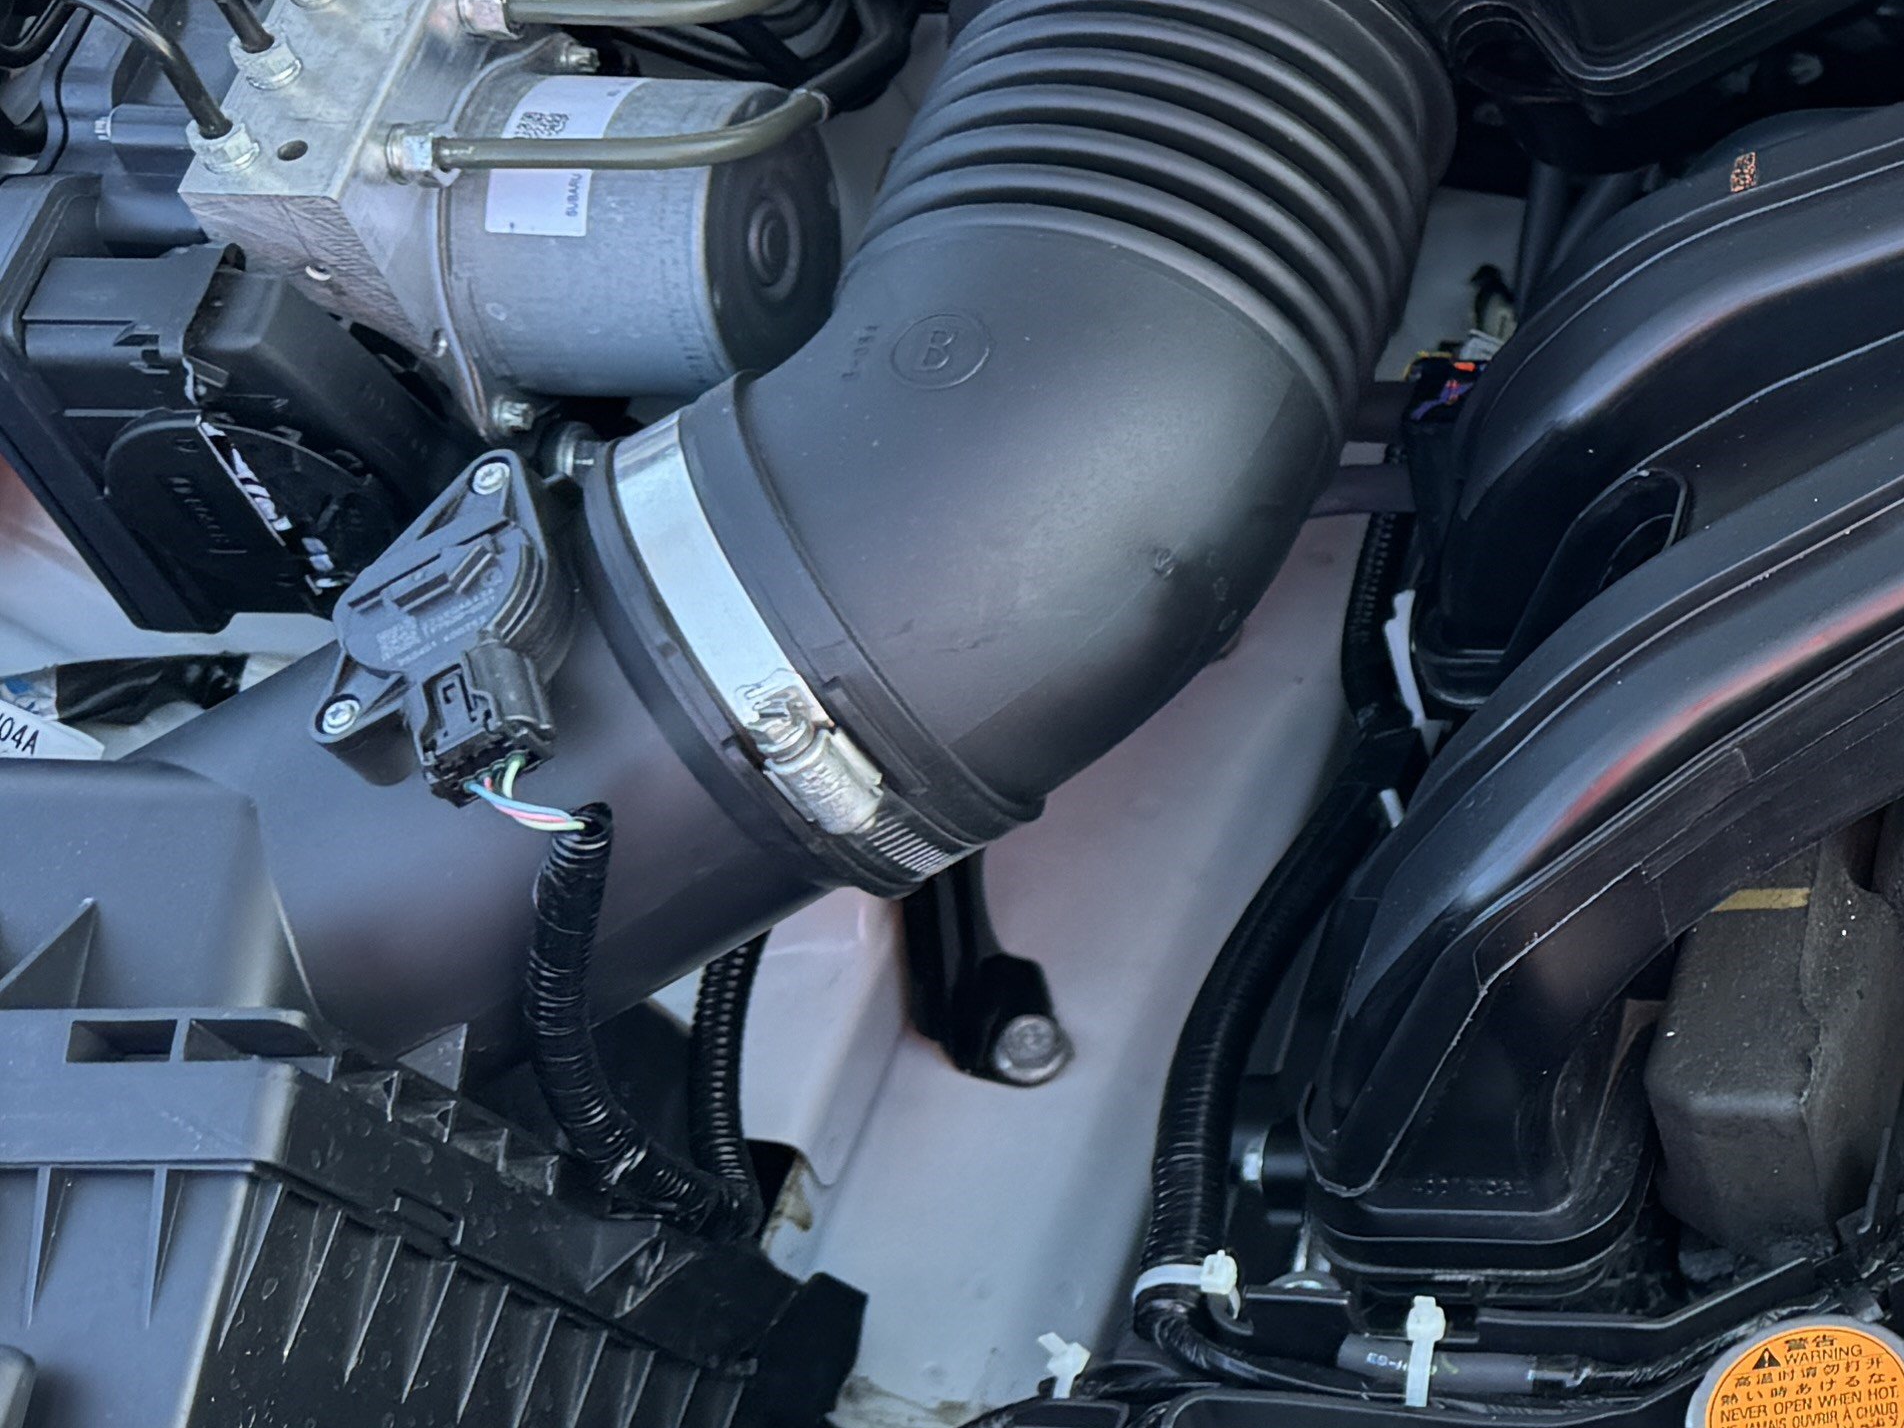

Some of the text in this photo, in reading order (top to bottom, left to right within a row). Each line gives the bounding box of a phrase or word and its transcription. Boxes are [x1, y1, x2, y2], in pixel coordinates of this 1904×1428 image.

[0, 713, 40, 756] 04A
[1784, 1343, 1863, 1366] WARNING
[1720, 1404, 1768, 1424] NEVER
[1773, 1397, 1813, 1417] OPEN
[1819, 1390, 1863, 1409] WHEN
